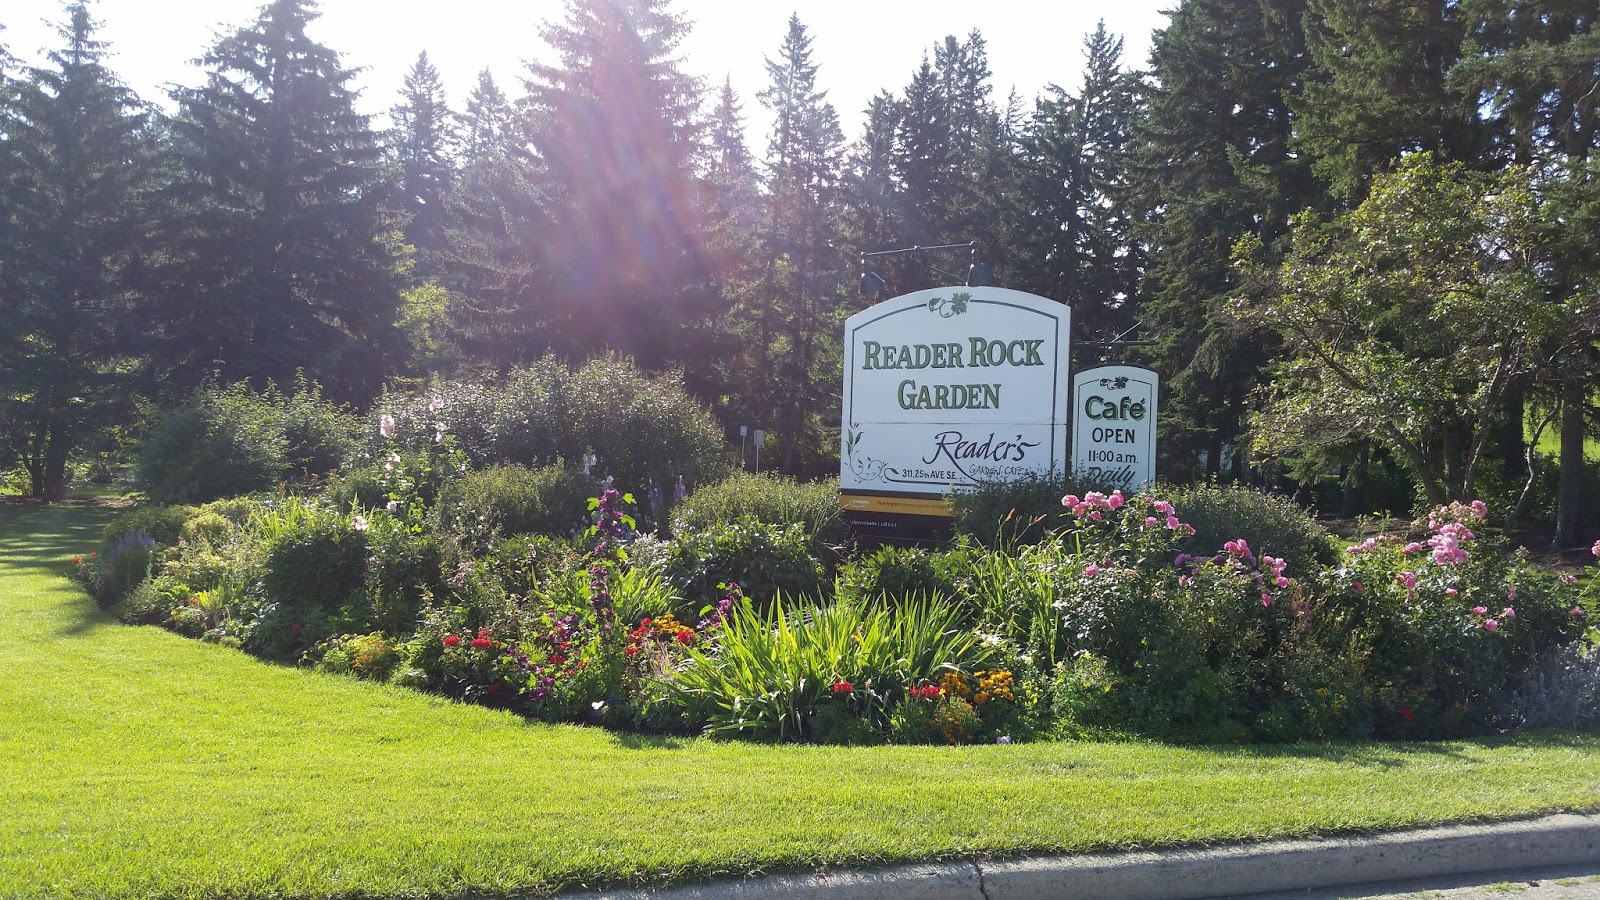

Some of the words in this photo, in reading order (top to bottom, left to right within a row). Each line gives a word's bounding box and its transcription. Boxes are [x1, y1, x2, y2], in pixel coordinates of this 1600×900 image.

[862, 340, 965, 370] READER
[967, 336, 1045, 368] ROCK
[897, 379, 1002, 410] GARDEN
[1084, 395, 1146, 420] Café
[1091, 427, 1135, 444] OPEN
[922, 430, 1042, 472] Reader's
[1088, 449, 1114, 463] 11:00
[1116, 453, 1139, 464] a.m.
[930, 470, 945, 480] AVE
[1087, 464, 1136, 488] Daily
